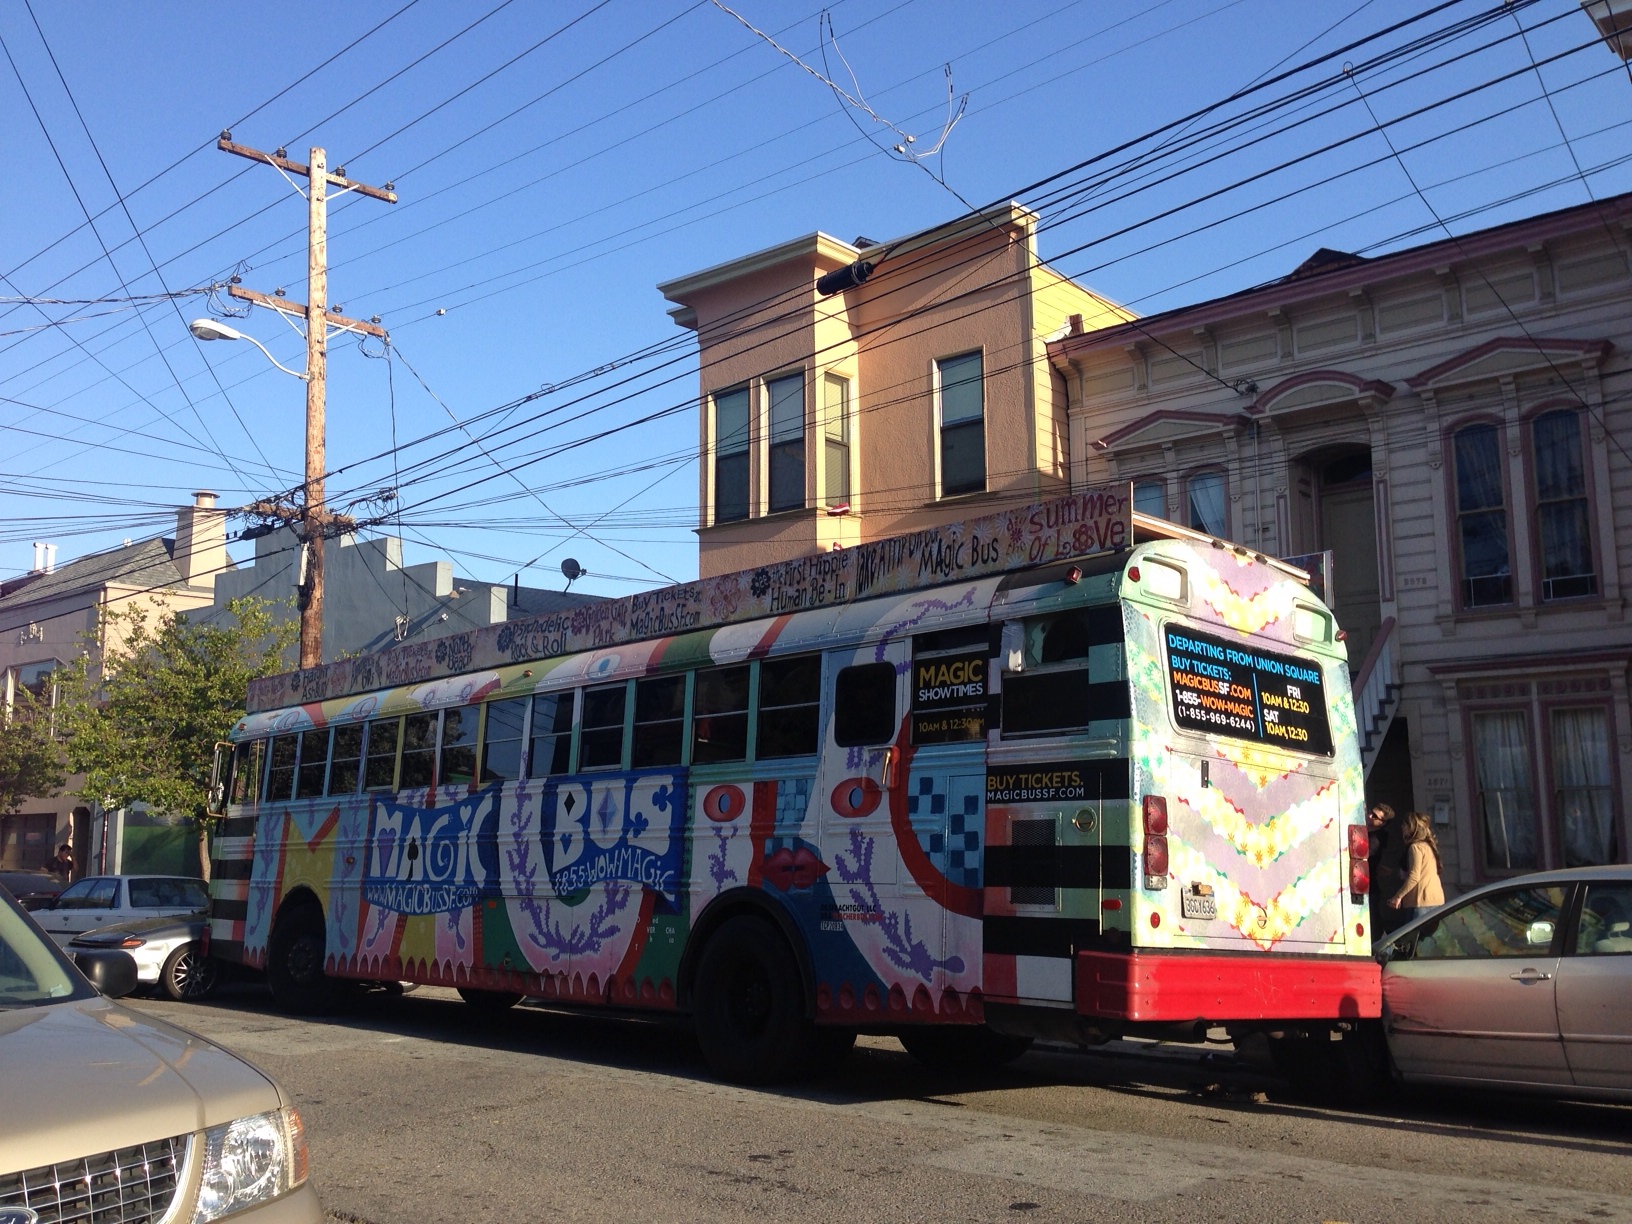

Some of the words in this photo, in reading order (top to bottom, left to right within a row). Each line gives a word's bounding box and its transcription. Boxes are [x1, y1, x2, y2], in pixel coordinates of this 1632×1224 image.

[809, 553, 849, 582] Hippie
[770, 586, 808, 612] Human
[1168, 633, 1224, 660] DEPARTING
[1226, 649, 1253, 667] FROM
[1254, 657, 1284, 675] UNION
[1285, 664, 1320, 684] SQUARE
[1171, 655, 1191, 672] BUY
[1192, 661, 1232, 681] TICKETS:
[919, 659, 983, 688] MAGIC
[1173, 671, 1252, 701] MAGICBUSSF.COM
[919, 683, 983, 702] SHOWTIMES
[1261, 692, 1283, 708] 10AM
[1289, 697, 1309, 714] 12:30
[1286, 684, 1301, 699] FRI
[941, 720, 948, 730] &
[1177, 706, 1255, 733] (1-855-969-6244)
[1263, 708, 1279, 724] SAT
[987, 787, 1085, 800] MAGICBUSSF.COM
[988, 775, 1016, 791] BUY
[1019, 771, 1084, 788] TICKETS.
[552, 775, 675, 874] BUS
